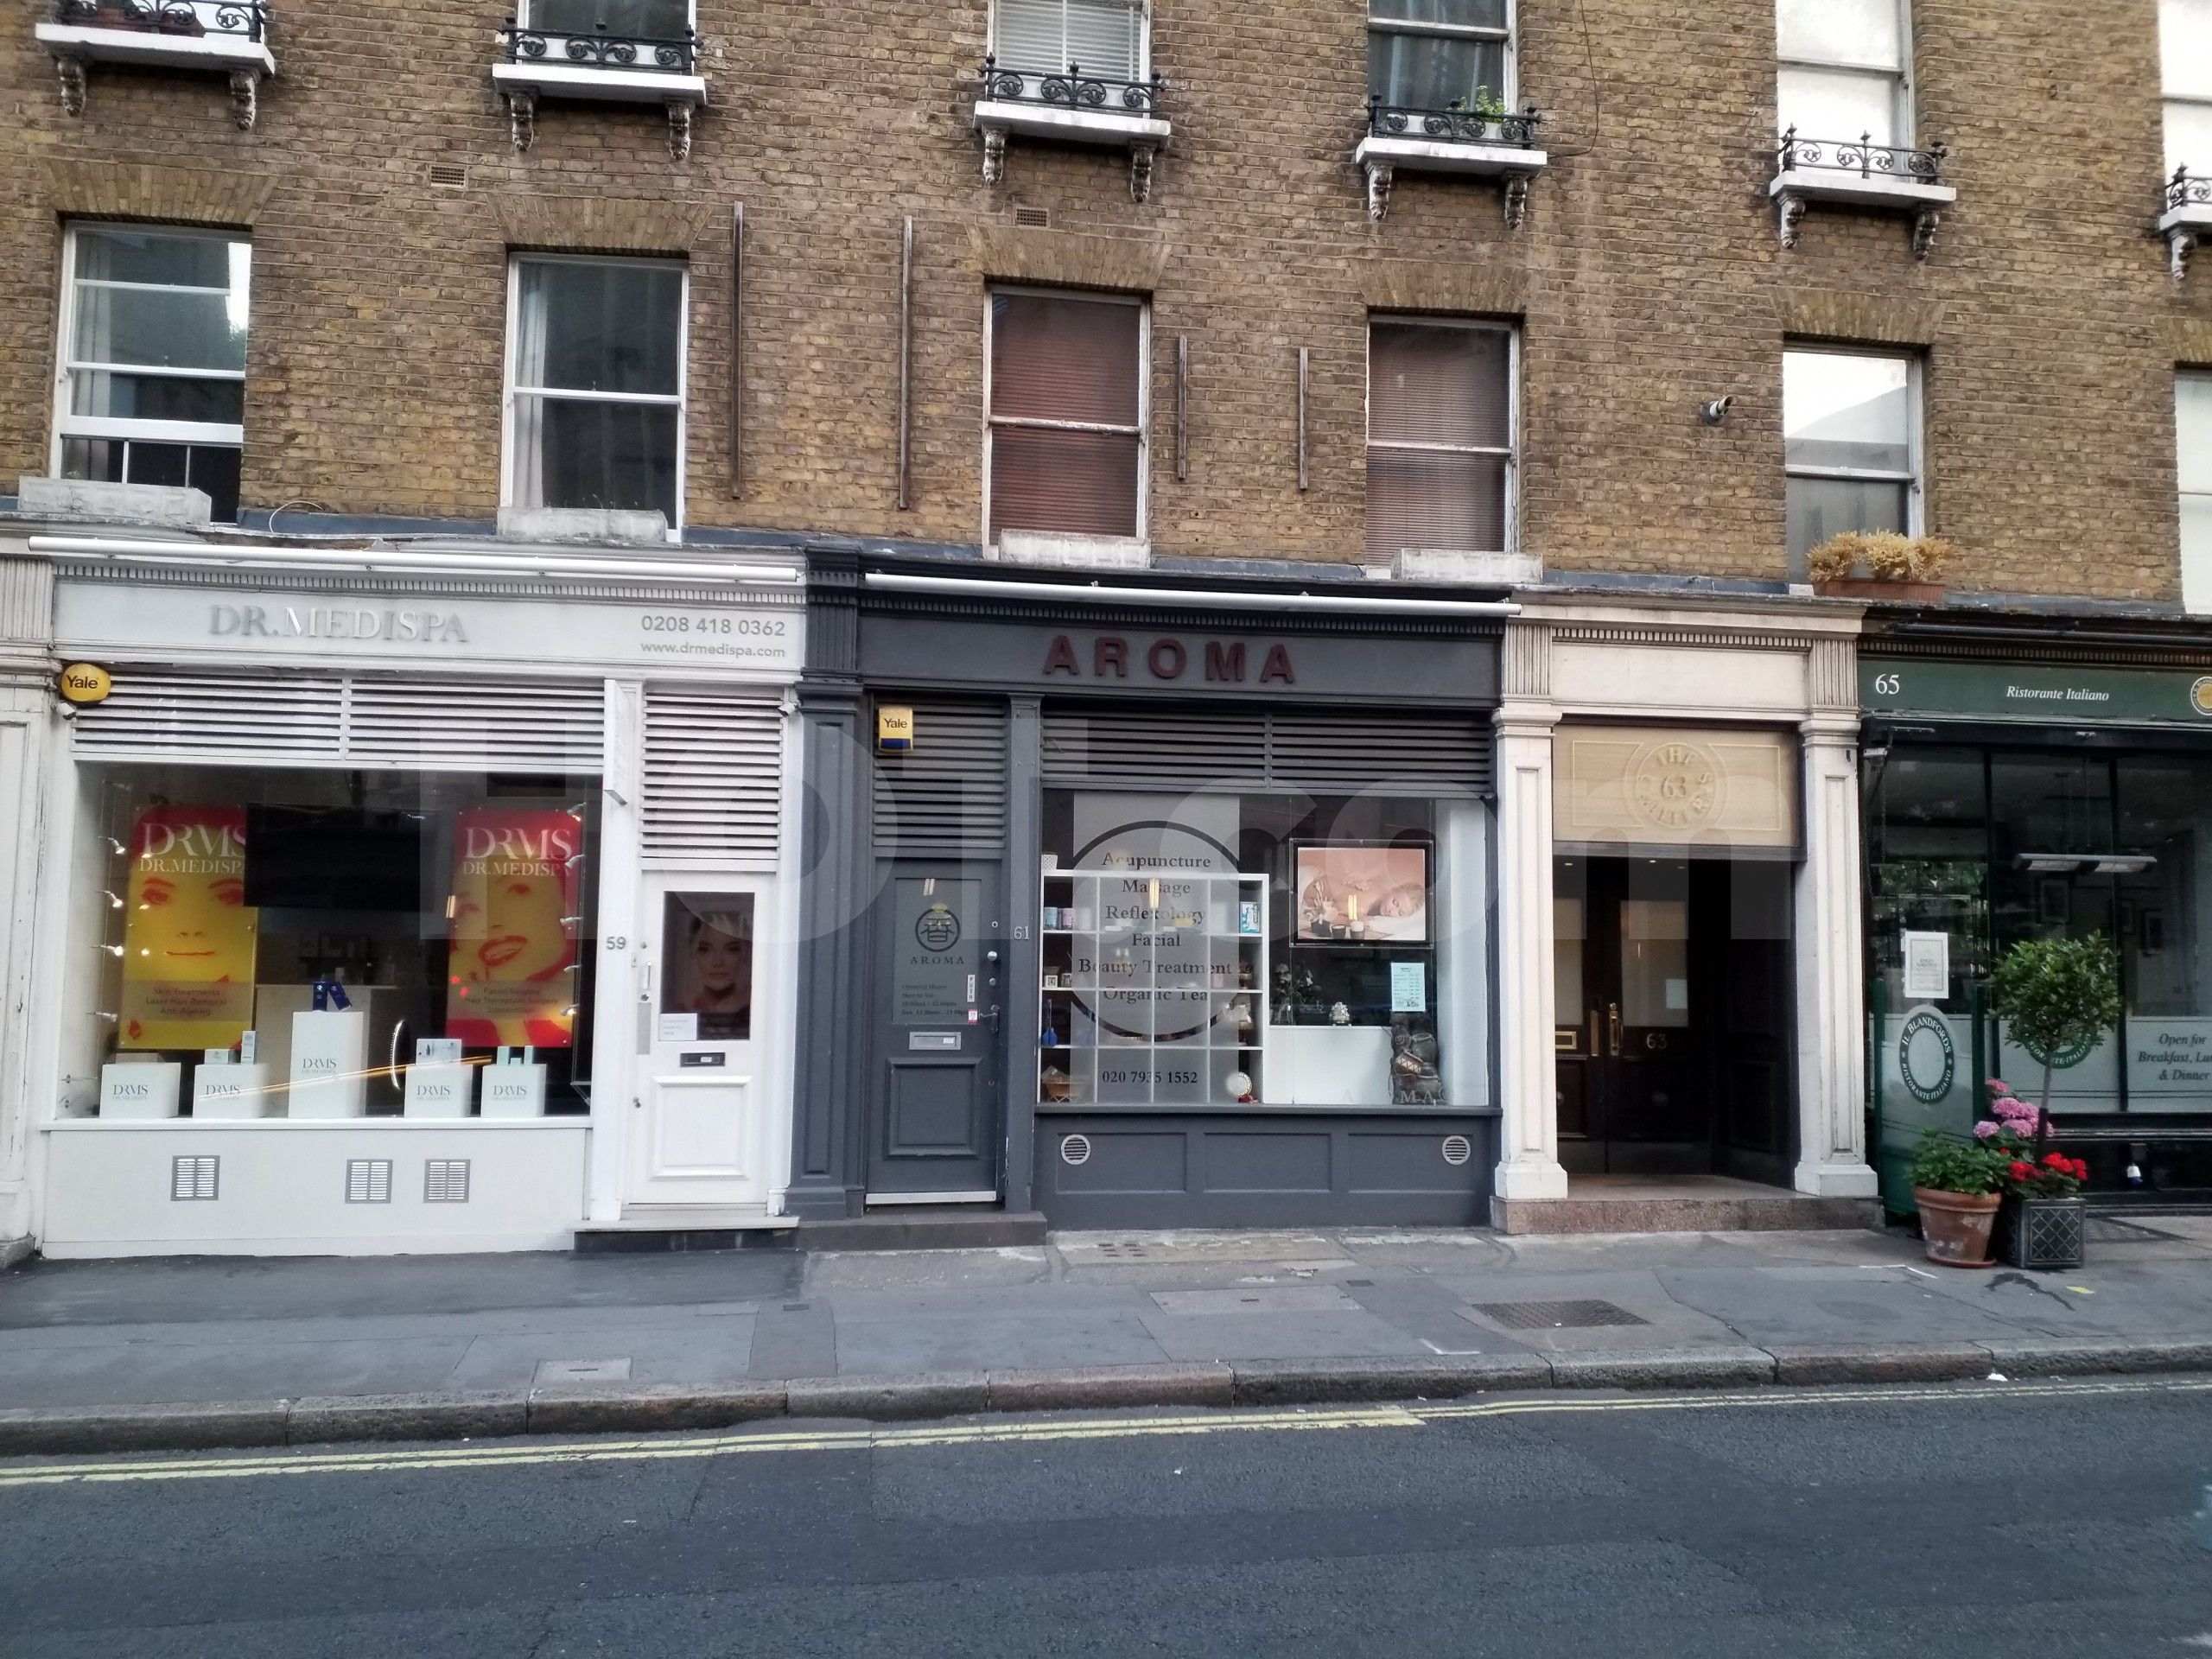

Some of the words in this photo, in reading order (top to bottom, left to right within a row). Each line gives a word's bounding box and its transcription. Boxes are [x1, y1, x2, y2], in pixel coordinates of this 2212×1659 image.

[208, 605, 469, 643] DR.MEDISPA
[640, 614, 690, 634] 0208
[696, 617, 732, 635] 418
[738, 619, 786, 638] 0362
[640, 641, 786, 659] www.drmedispa.com
[1045, 634, 1295, 684] AROMA
[66, 674, 99, 690] Yale
[1874, 673, 1900, 696] 65
[2006, 685, 2063, 700] Ristorante
[2066, 688, 2109, 702] Italiano
[883, 717, 908, 730] Yale
[1661, 774, 1688, 799] 63
[464, 827, 573, 861] DRMS
[140, 858, 245, 874] DR.MEDISP
[1123, 879, 1192, 898] Maage
[1013, 925, 1030, 940] 61
[1132, 933, 1181, 947] Facial
[606, 936, 626, 950] 59
[910, 955, 965, 965] AROMA
[1079, 958, 1138, 977] Beauty
[1143, 959, 1232, 976] Treatment
[1103, 986, 1172, 1004] Organic
[1176, 987, 1208, 1001] Tea
[1646, 1033, 1667, 1049] 63
[1902, 1035, 1910, 1046] IL
[1907, 1016, 1952, 1053] BLANDFORDS
[2158, 1033, 2188, 1047] Open
[2189, 1033, 2207, 1047] for
[2138, 1051, 2193, 1065] Breakfast,
[1102, 1071, 1126, 1084] 020
[1131, 1071, 1162, 1084] 7935
[1167, 1071, 1198, 1084] 1552
[2158, 1069, 2169, 1080] &
[2172, 1069, 2211, 1080] Dinner
